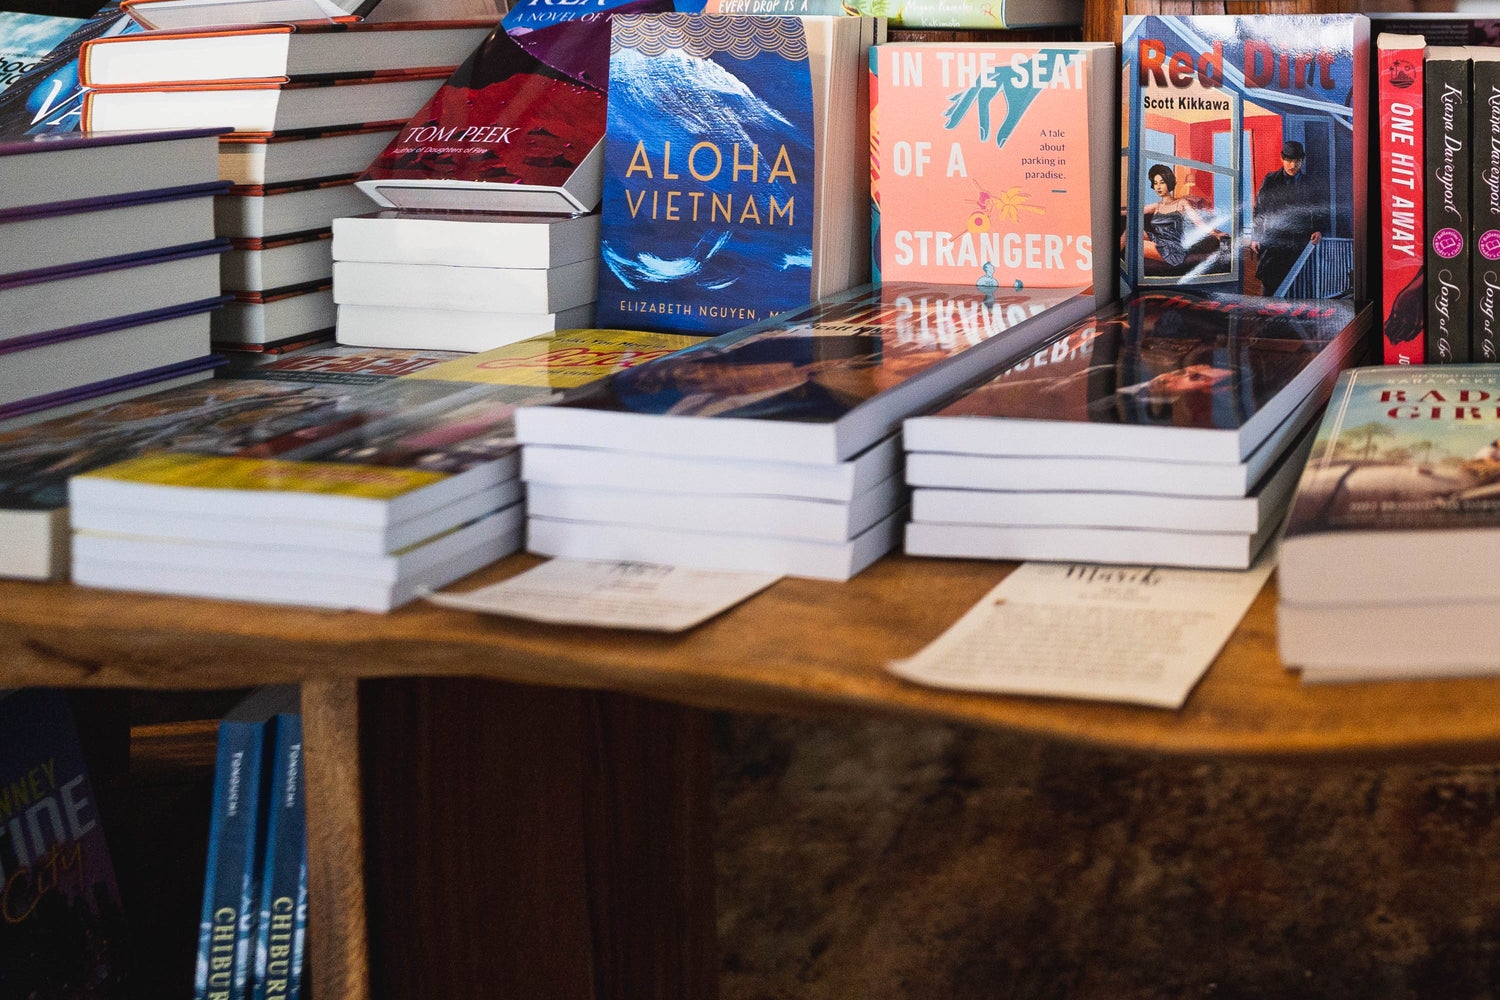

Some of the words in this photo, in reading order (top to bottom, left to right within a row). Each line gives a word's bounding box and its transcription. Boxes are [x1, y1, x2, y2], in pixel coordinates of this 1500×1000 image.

[512, 13, 524, 22] A
[527, 12, 576, 22] NOVEL
[581, 12, 605, 22] OF
[892, 52, 922, 88] IN
[937, 52, 997, 88] THE
[1010, 53, 1087, 90] SEAT
[1139, 38, 1224, 89] Red
[1243, 39, 1336, 90] Dirt
[1144, 96, 1175, 110] Scott
[1178, 97, 1230, 111] Kikkawa
[1439, 82, 1463, 130] Kiana
[404, 126, 458, 143] TOM
[458, 126, 521, 144] PEEK
[1040, 129, 1048, 137] A
[1050, 128, 1065, 138] tale
[1390, 102, 1414, 145] ONE
[625, 139, 797, 184] ALOHA
[893, 141, 931, 177] OF
[946, 142, 968, 178] A
[1021, 156, 1056, 167] parking
[1057, 156, 1066, 165] in
[1039, 142, 1065, 151] about
[1025, 170, 1067, 180] paradise.
[1391, 151, 1415, 190] HIT
[1435, 134, 1462, 223] Davenport
[625, 189, 795, 226] VIETNAM
[1392, 194, 1415, 257] AWAY
[895, 230, 1093, 271] STRANGER'S
[620, 301, 692, 317] ELIZABETH
[699, 306, 762, 322] NGUYEN,
[1434, 268, 1461, 320] Song
